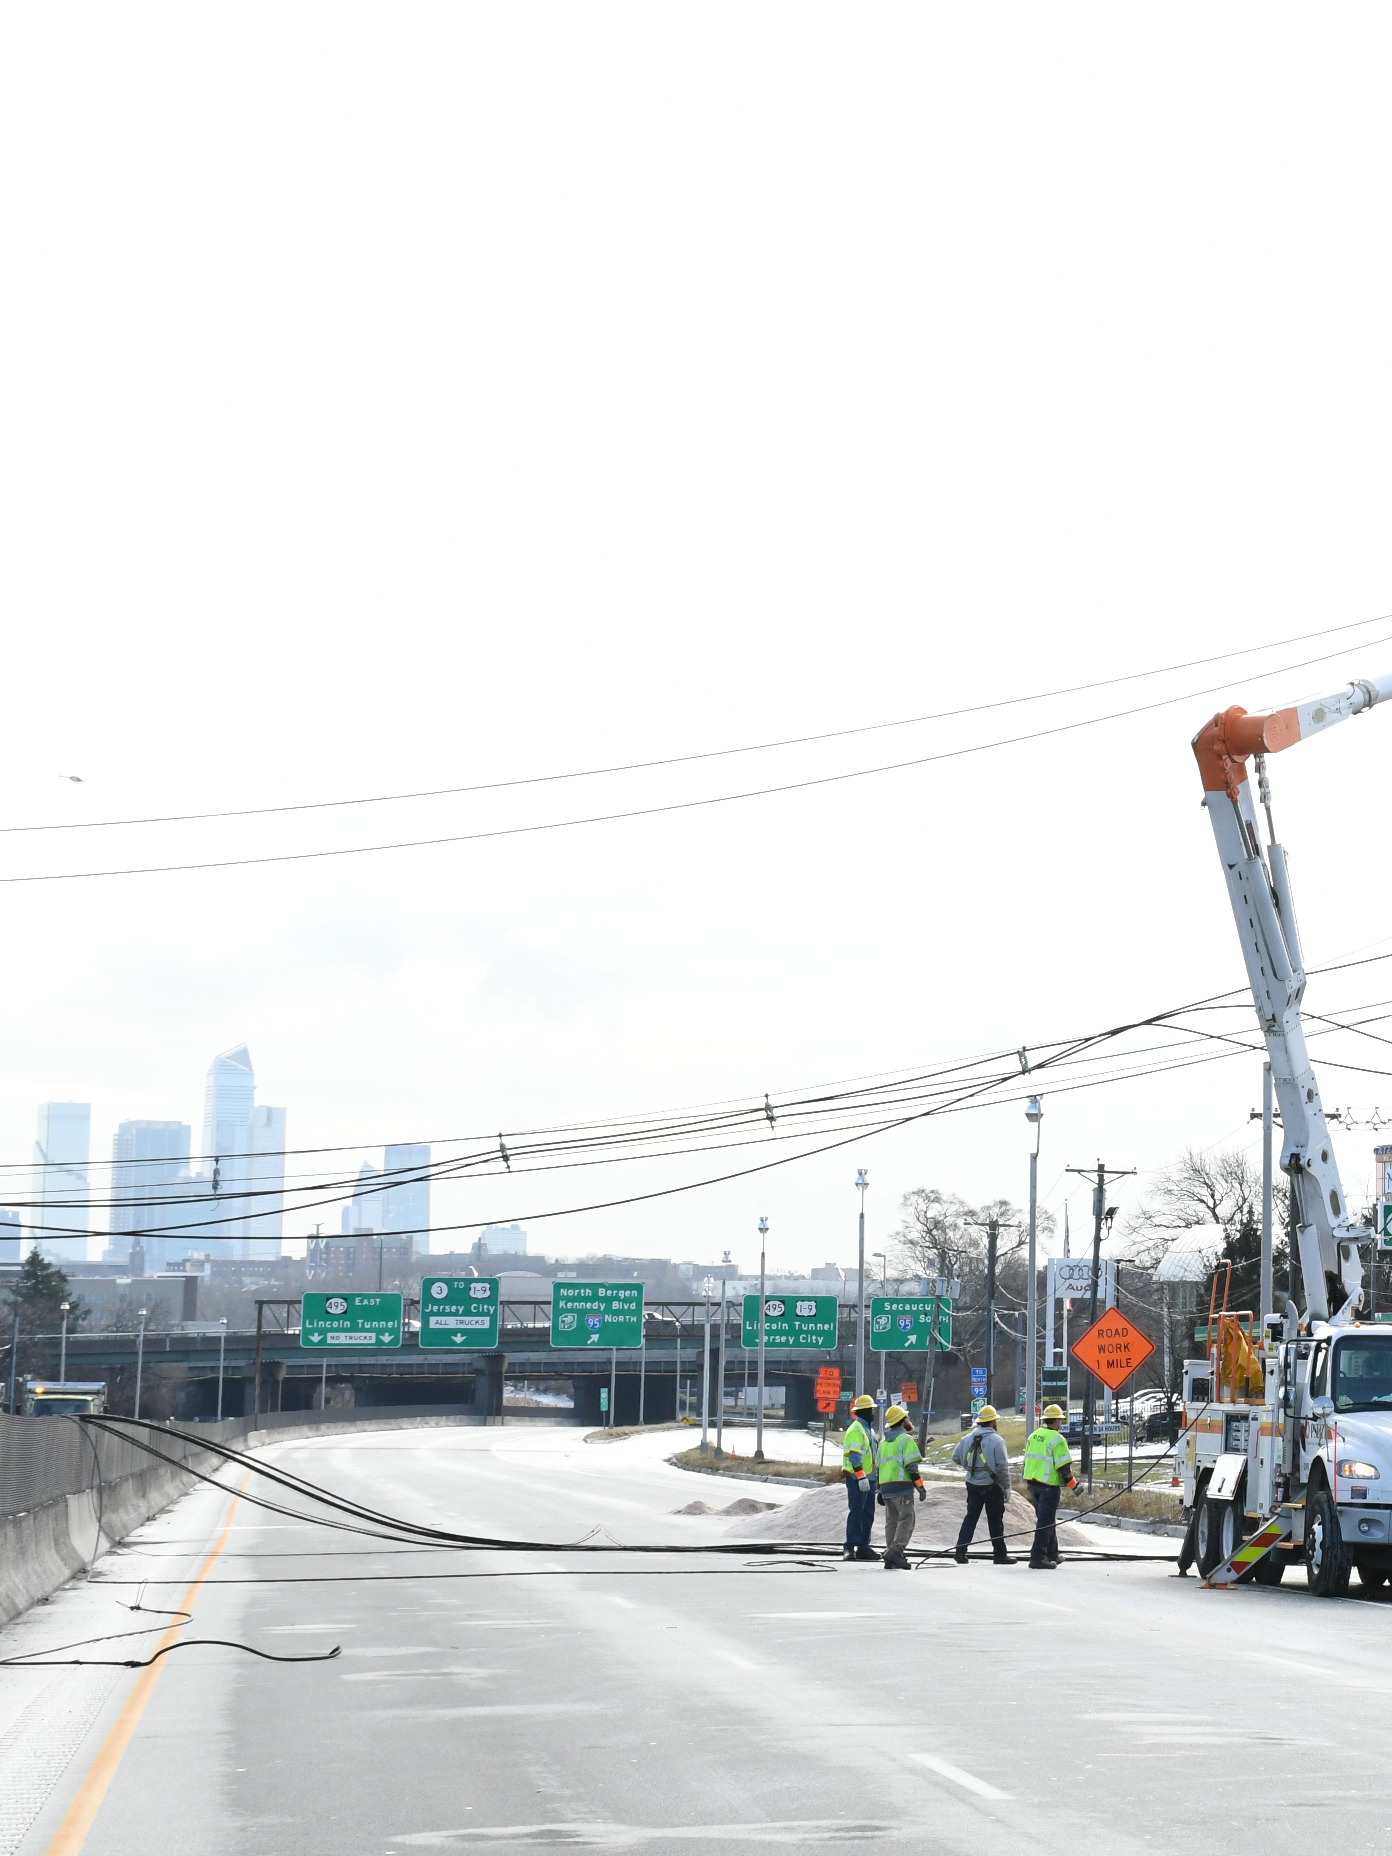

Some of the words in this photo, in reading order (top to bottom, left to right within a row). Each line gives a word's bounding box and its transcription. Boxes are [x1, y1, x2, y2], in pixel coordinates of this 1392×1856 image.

[436, 1286, 443, 1295] 3
[454, 1281, 465, 1289] TO
[473, 1286, 487, 1295] 1-9
[1065, 1283, 1093, 1292] Aud
[560, 1288, 592, 1297] North
[598, 1288, 638, 1299] Bergen
[326, 1301, 346, 1311] 495
[355, 1297, 381, 1306] EAST
[424, 1303, 465, 1315] Jersey
[471, 1303, 496, 1315] City
[559, 1301, 606, 1311] Kennedy
[612, 1301, 636, 1310] Blvd
[765, 1303, 783, 1313] 495
[799, 1304, 813, 1314] 1-9
[587, 1319, 600, 1328] 95
[604, 1314, 637, 1323] NORTH
[919, 1314, 949, 1323] SOTH
[305, 1319, 351, 1328] Lincoln
[357, 1319, 398, 1329] Tunnel
[794, 1321, 834, 1331] Tunnel
[899, 1319, 911, 1329] 95
[1097, 1328, 1129, 1339] ROAD
[799, 1334, 824, 1346] City
[1097, 1343, 1131, 1354] WORK
[1096, 1360, 1101, 1370] 1
[1106, 1358, 1133, 1369] MILE
[824, 1369, 834, 1377] TO
[973, 1387, 985, 1395] 95
[1105, 1424, 1120, 1433] HOURS
